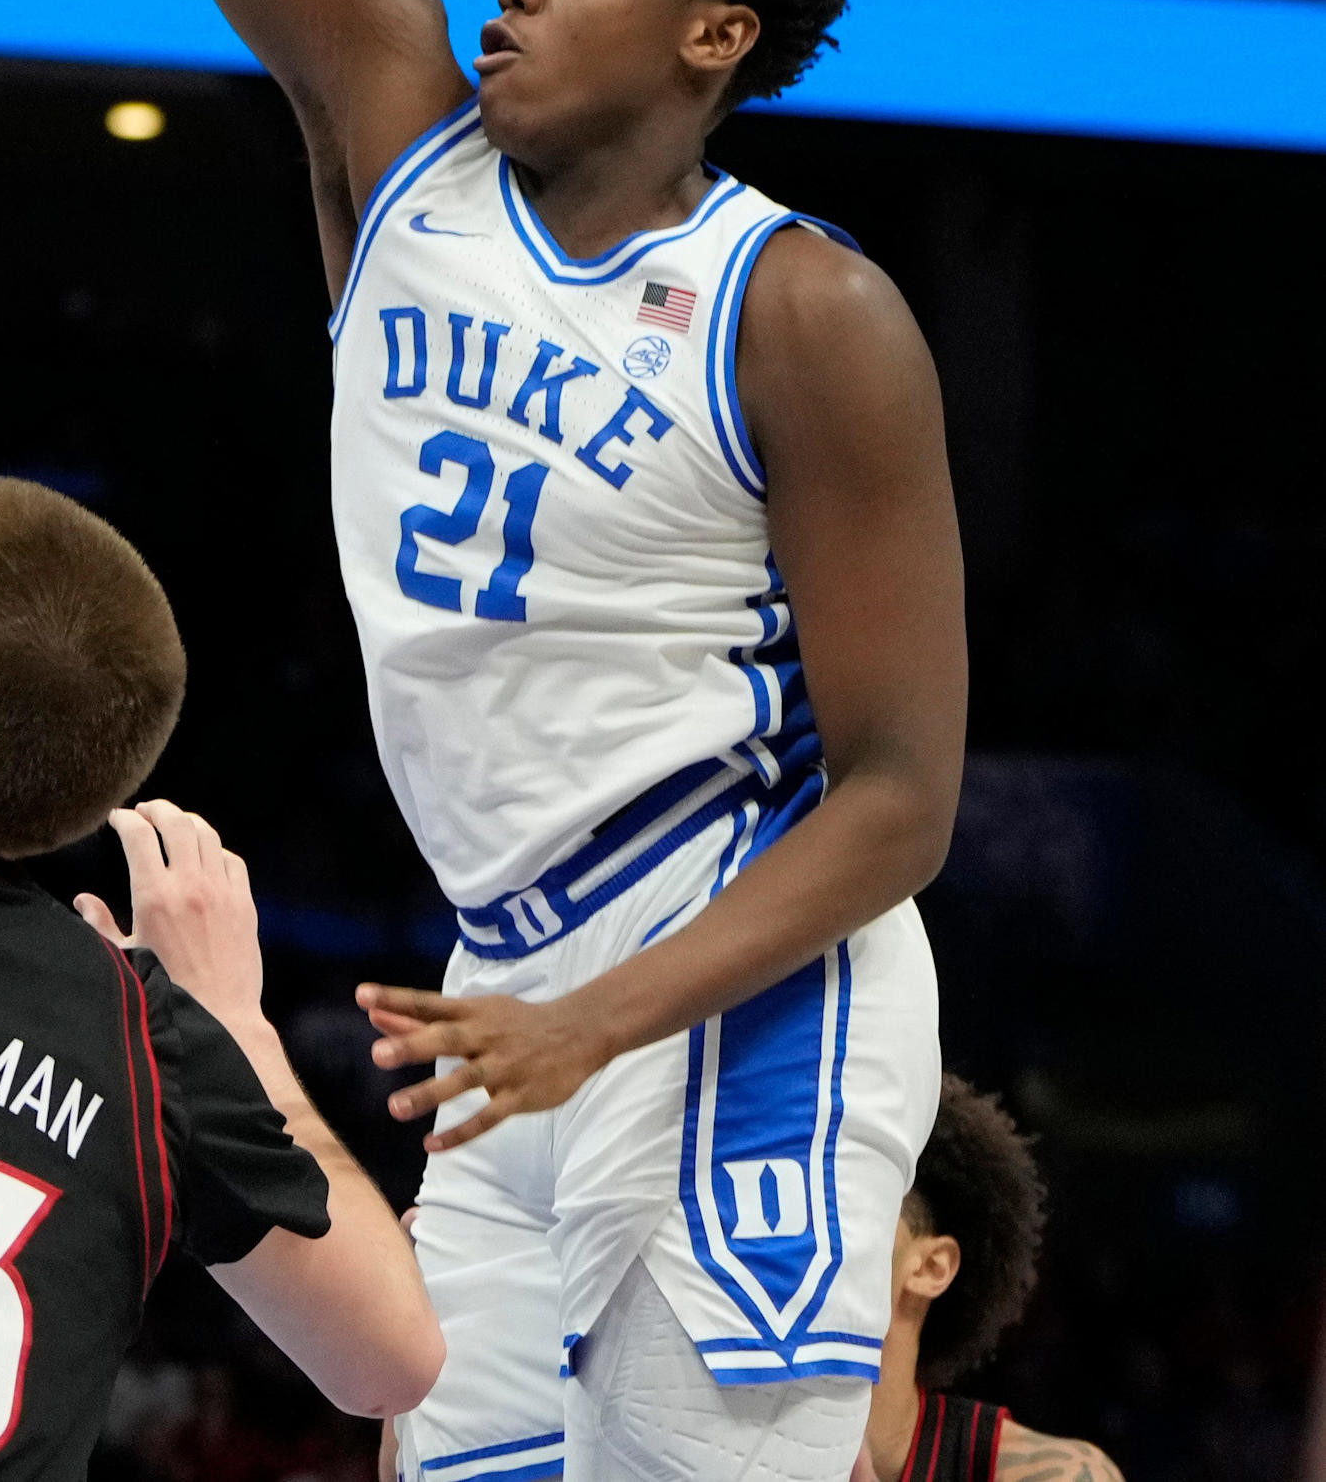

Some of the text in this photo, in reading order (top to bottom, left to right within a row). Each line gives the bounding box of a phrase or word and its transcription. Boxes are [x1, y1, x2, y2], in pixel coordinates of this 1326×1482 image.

[379, 306, 674, 491] DUKE
[395, 430, 550, 622] 21
[502, 886, 563, 948] D
[722, 1158, 808, 1239] D
